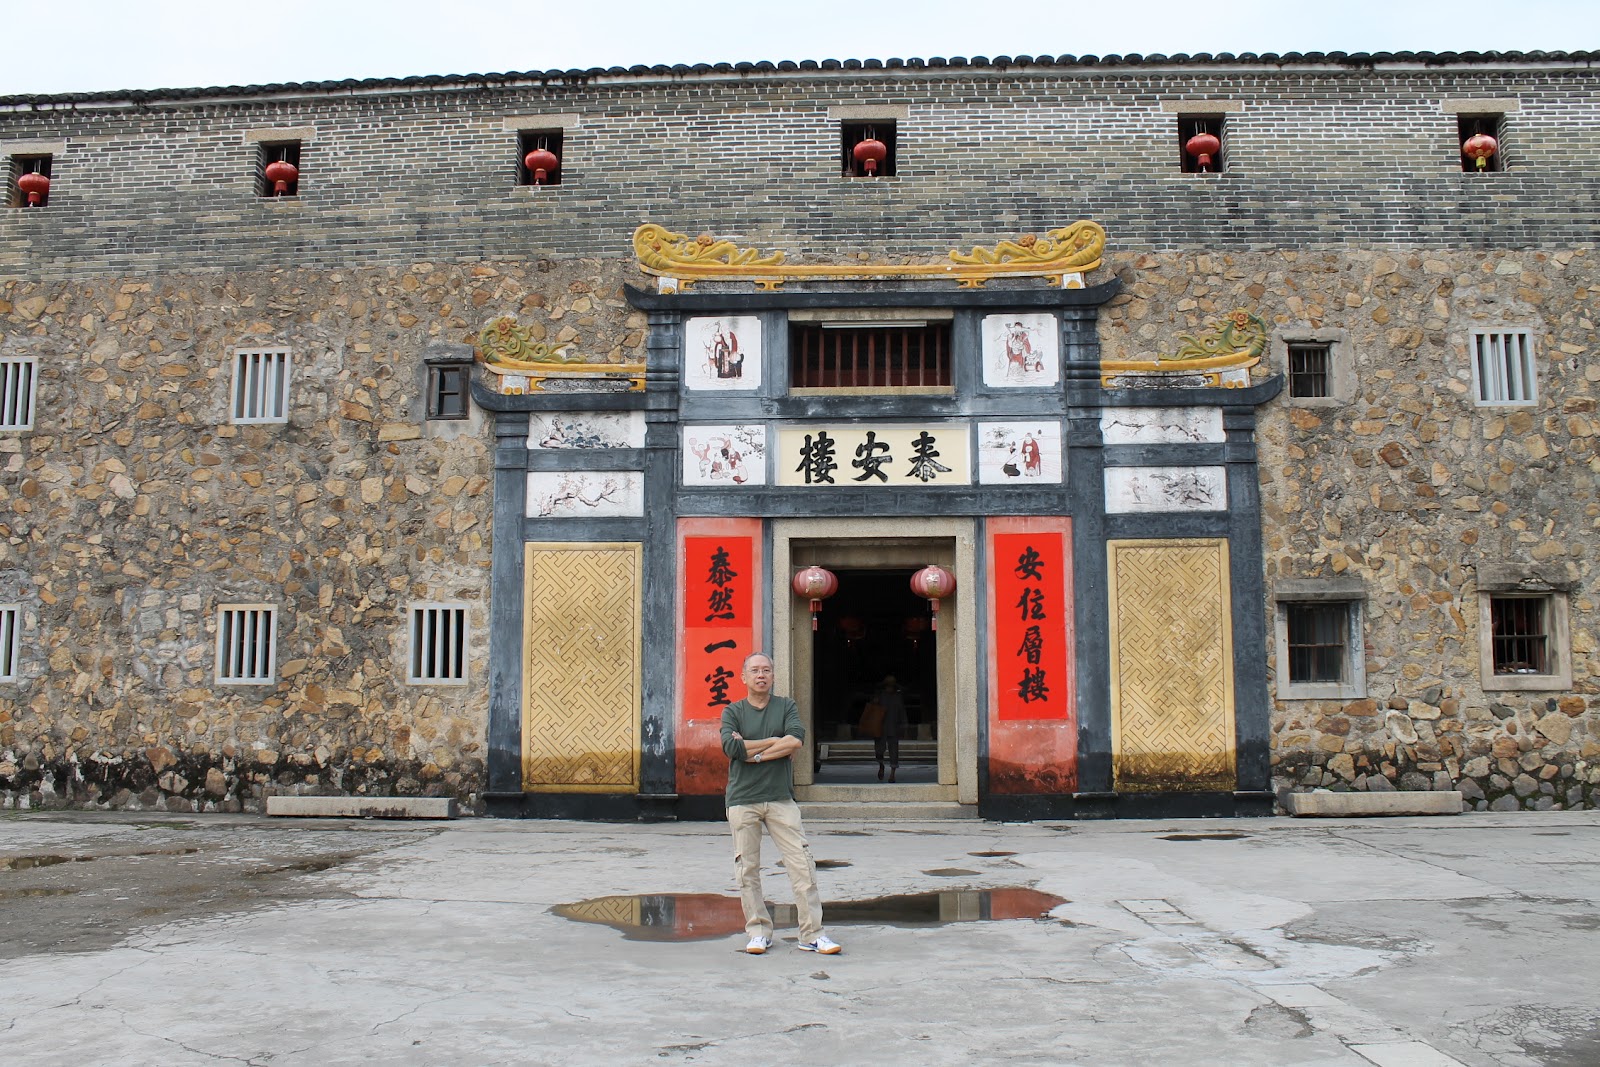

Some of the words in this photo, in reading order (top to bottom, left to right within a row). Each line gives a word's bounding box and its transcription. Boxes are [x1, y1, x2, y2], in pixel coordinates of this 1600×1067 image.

[704, 546, 738, 707] 泰然一室
[1014, 546, 1050, 704] 安住層樓
